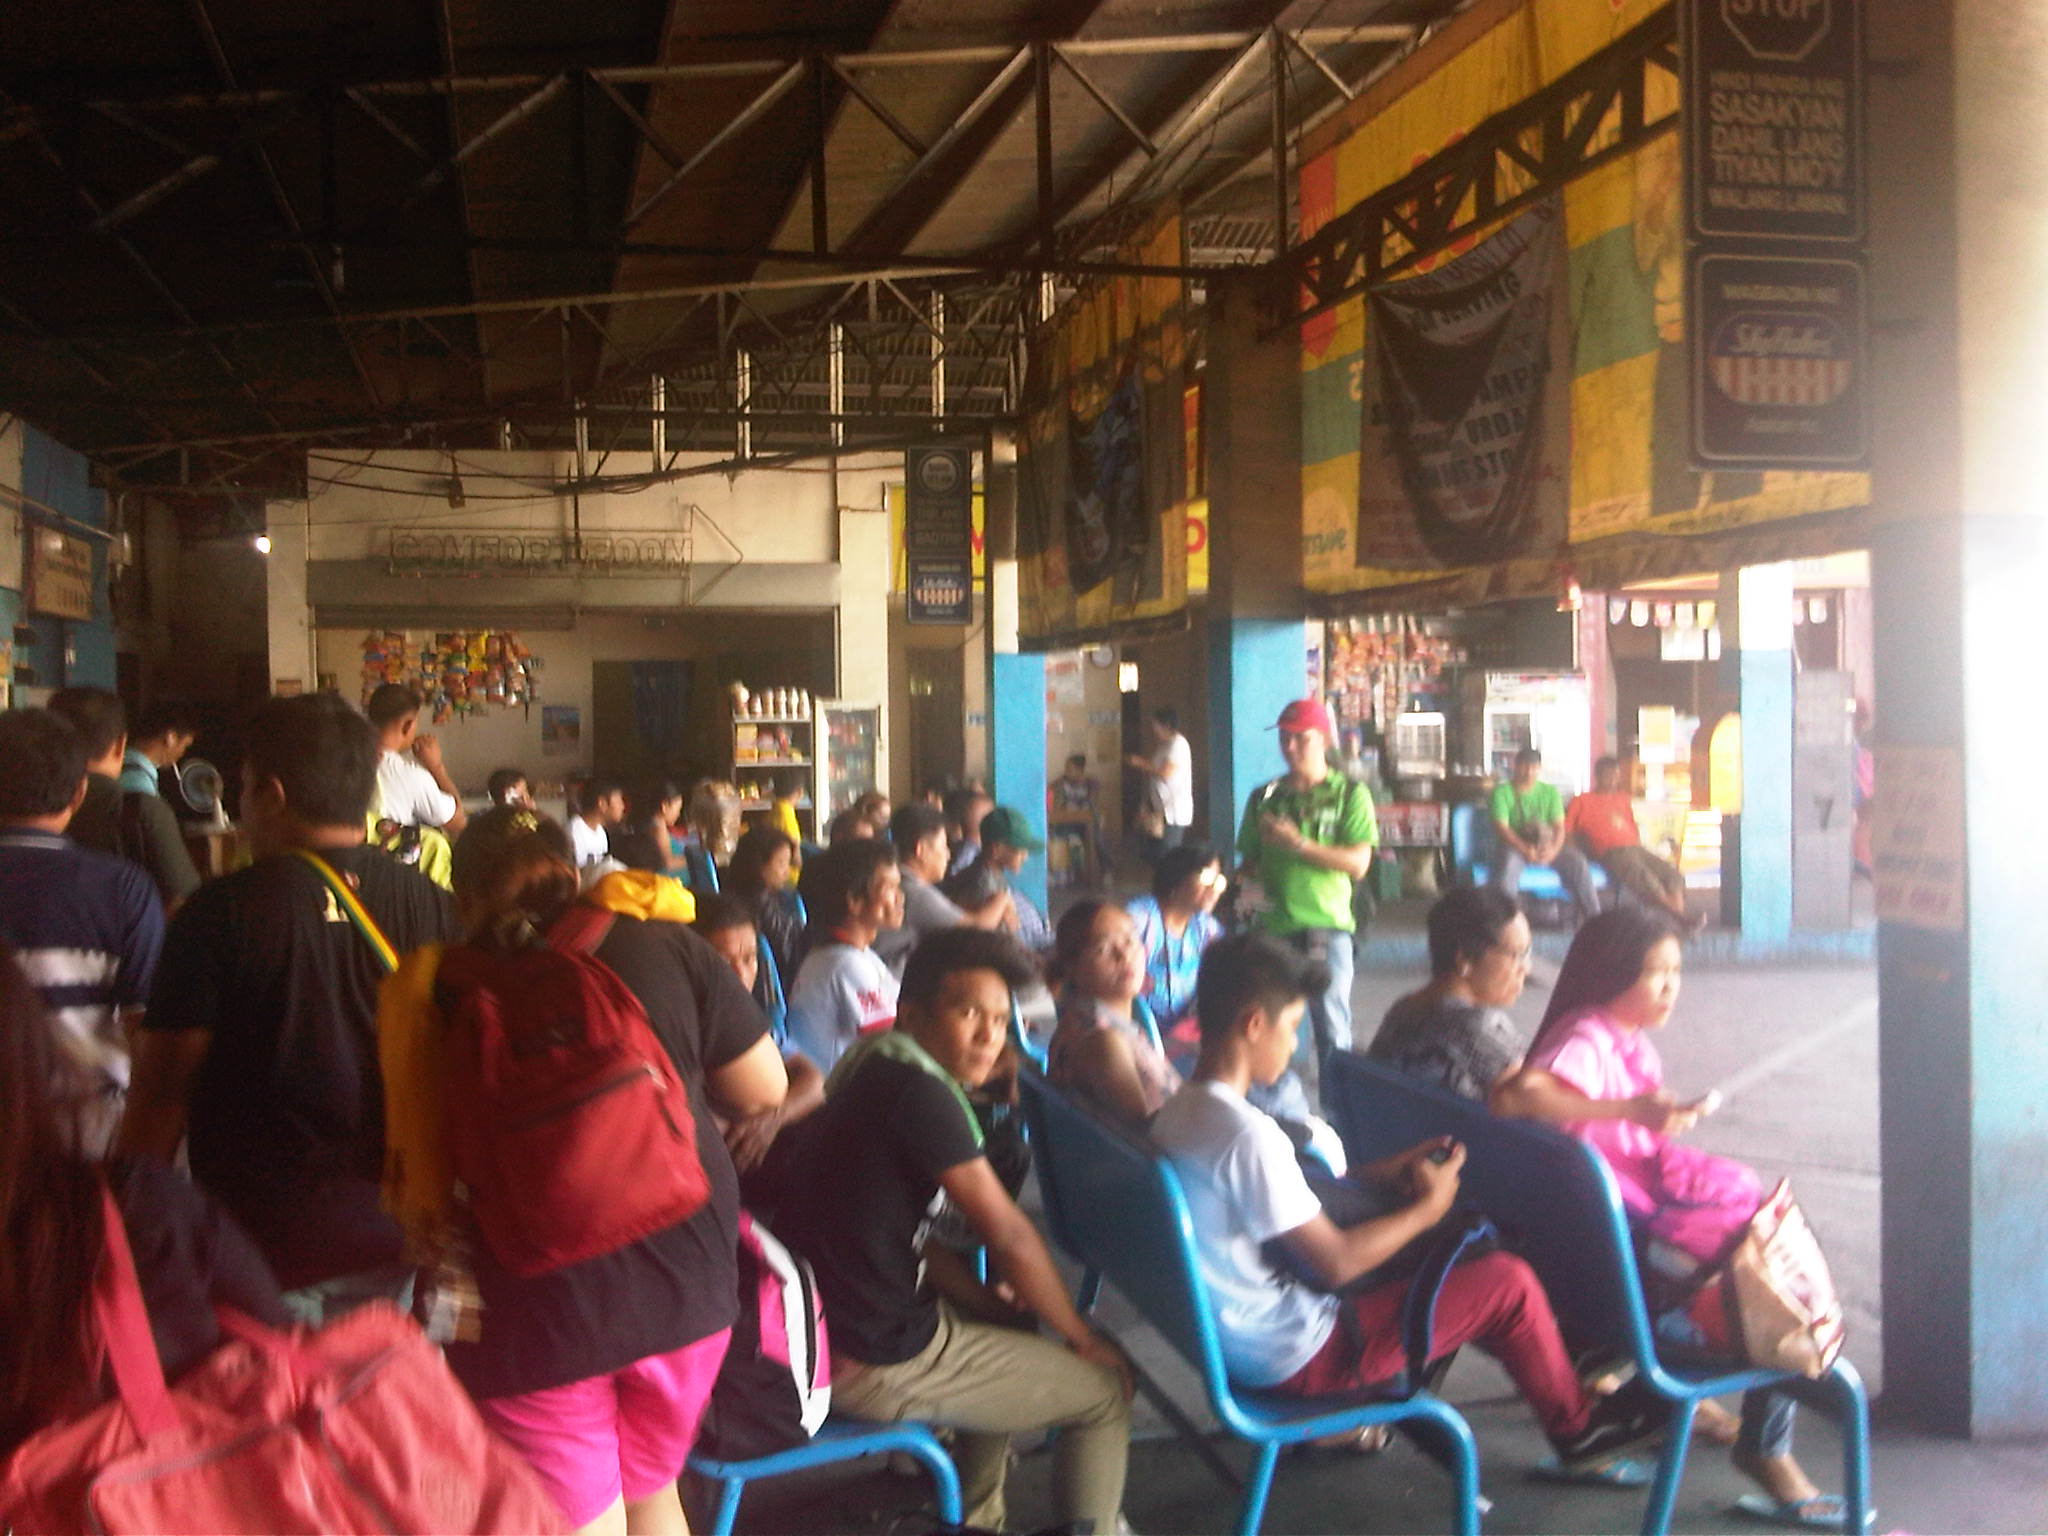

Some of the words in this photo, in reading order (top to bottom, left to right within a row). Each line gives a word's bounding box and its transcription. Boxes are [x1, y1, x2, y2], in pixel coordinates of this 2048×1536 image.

[1710, 91, 1846, 131] SASAKYAN
[1711, 124, 1780, 155] DAHIL
[1784, 129, 1846, 160] LANG
[1711, 153, 1781, 184] TIYAN
[392, 534, 574, 569] COMFORT
[584, 536, 693, 570] ROOM
